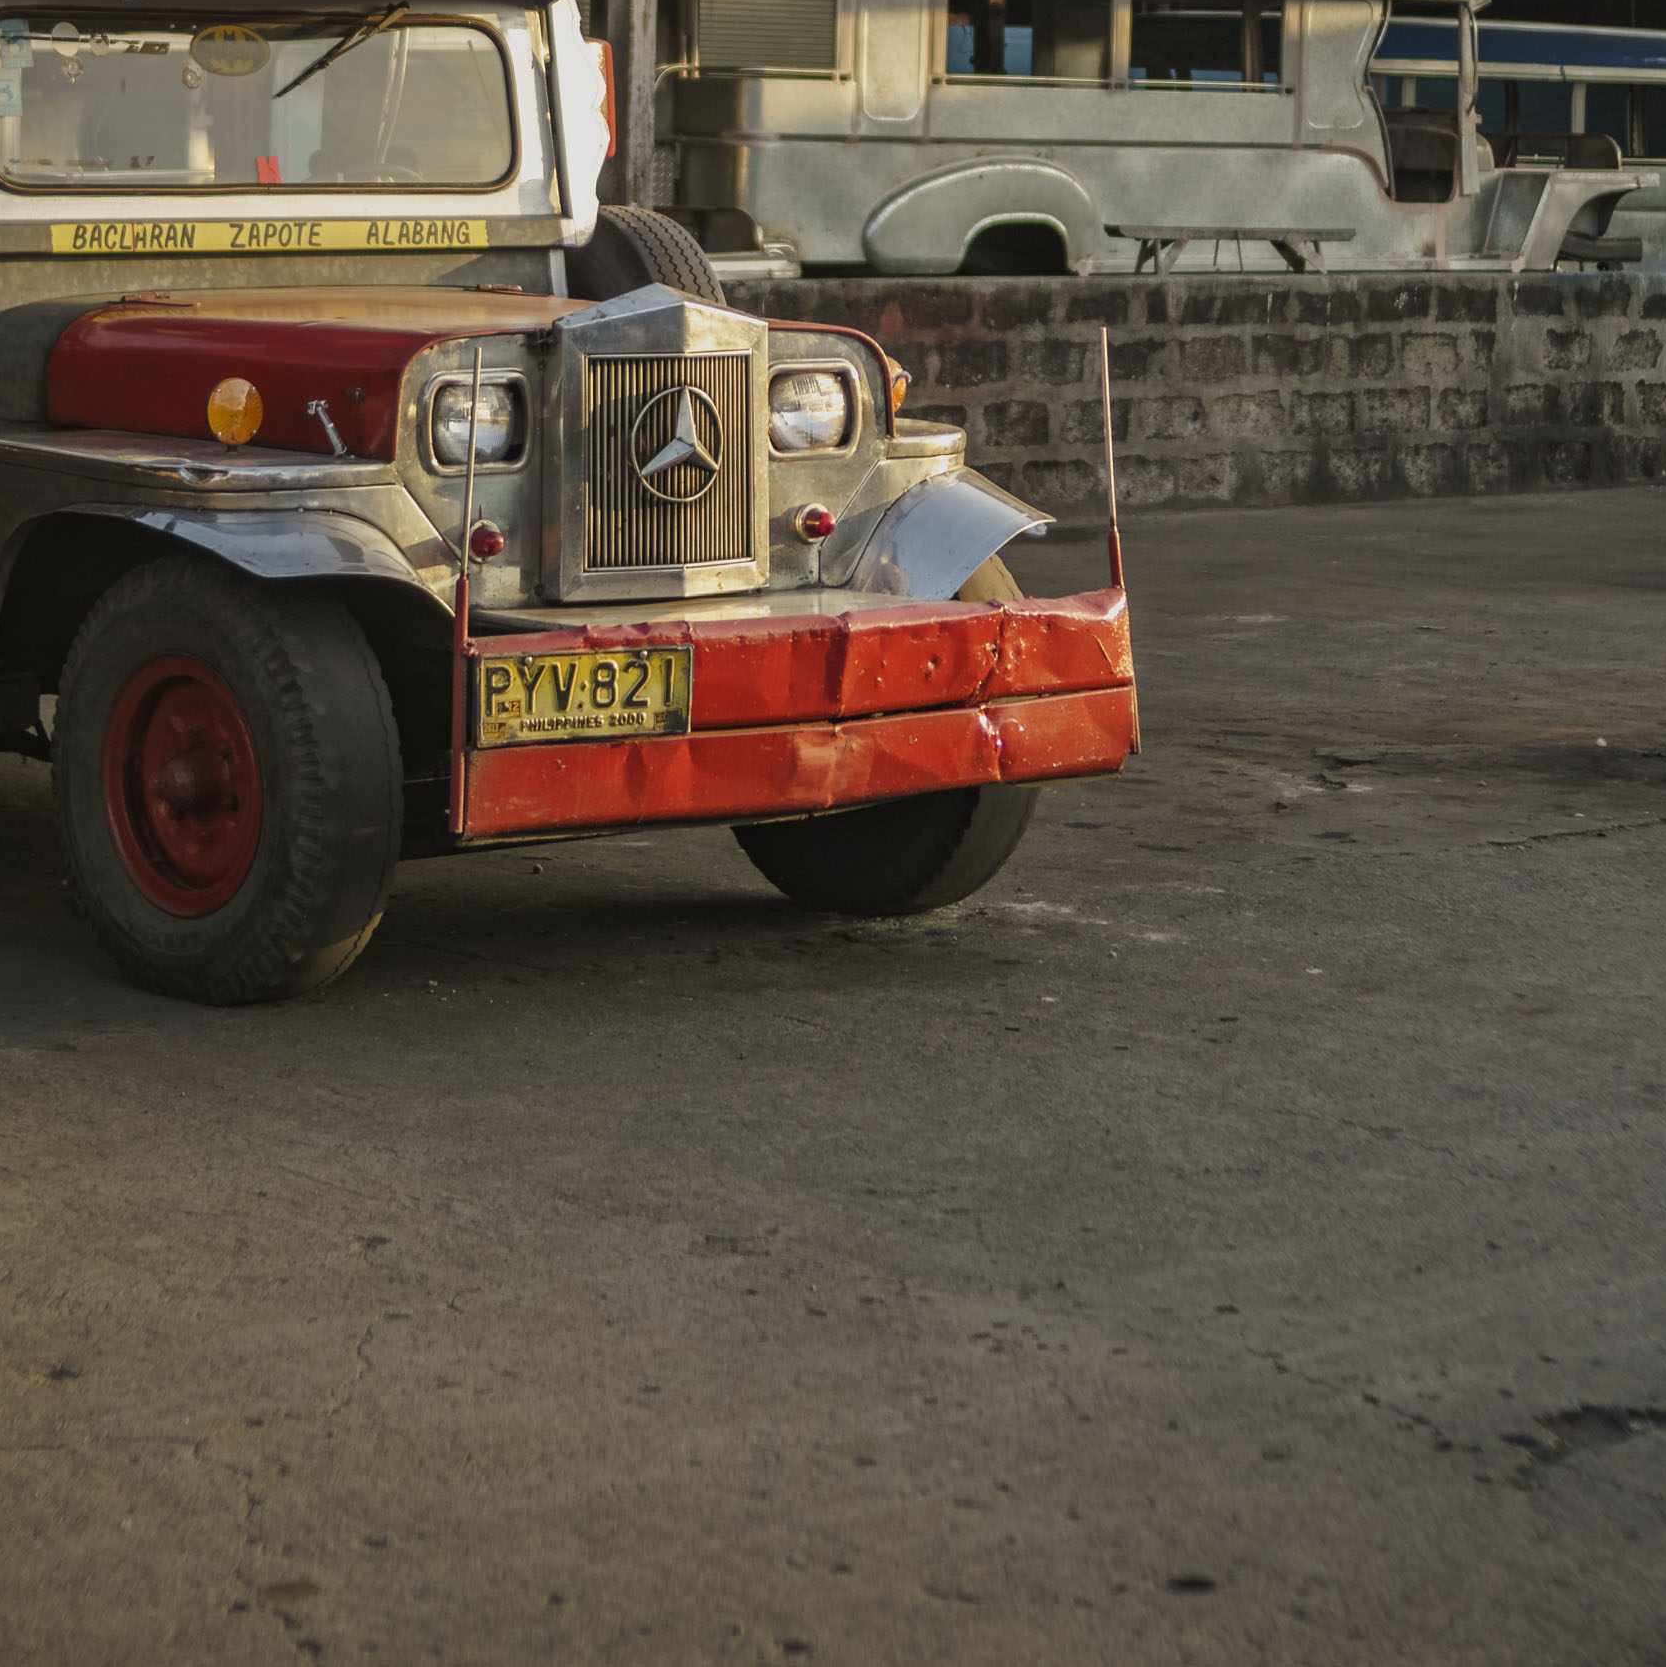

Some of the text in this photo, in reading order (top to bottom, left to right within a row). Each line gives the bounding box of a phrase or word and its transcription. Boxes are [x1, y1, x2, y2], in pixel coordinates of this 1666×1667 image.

[73, 221, 471, 250] BACLARAN ZAPOTE ALABANG
[520, 714, 605, 733] PHILIPPINES
[609, 711, 647, 726] 2000
